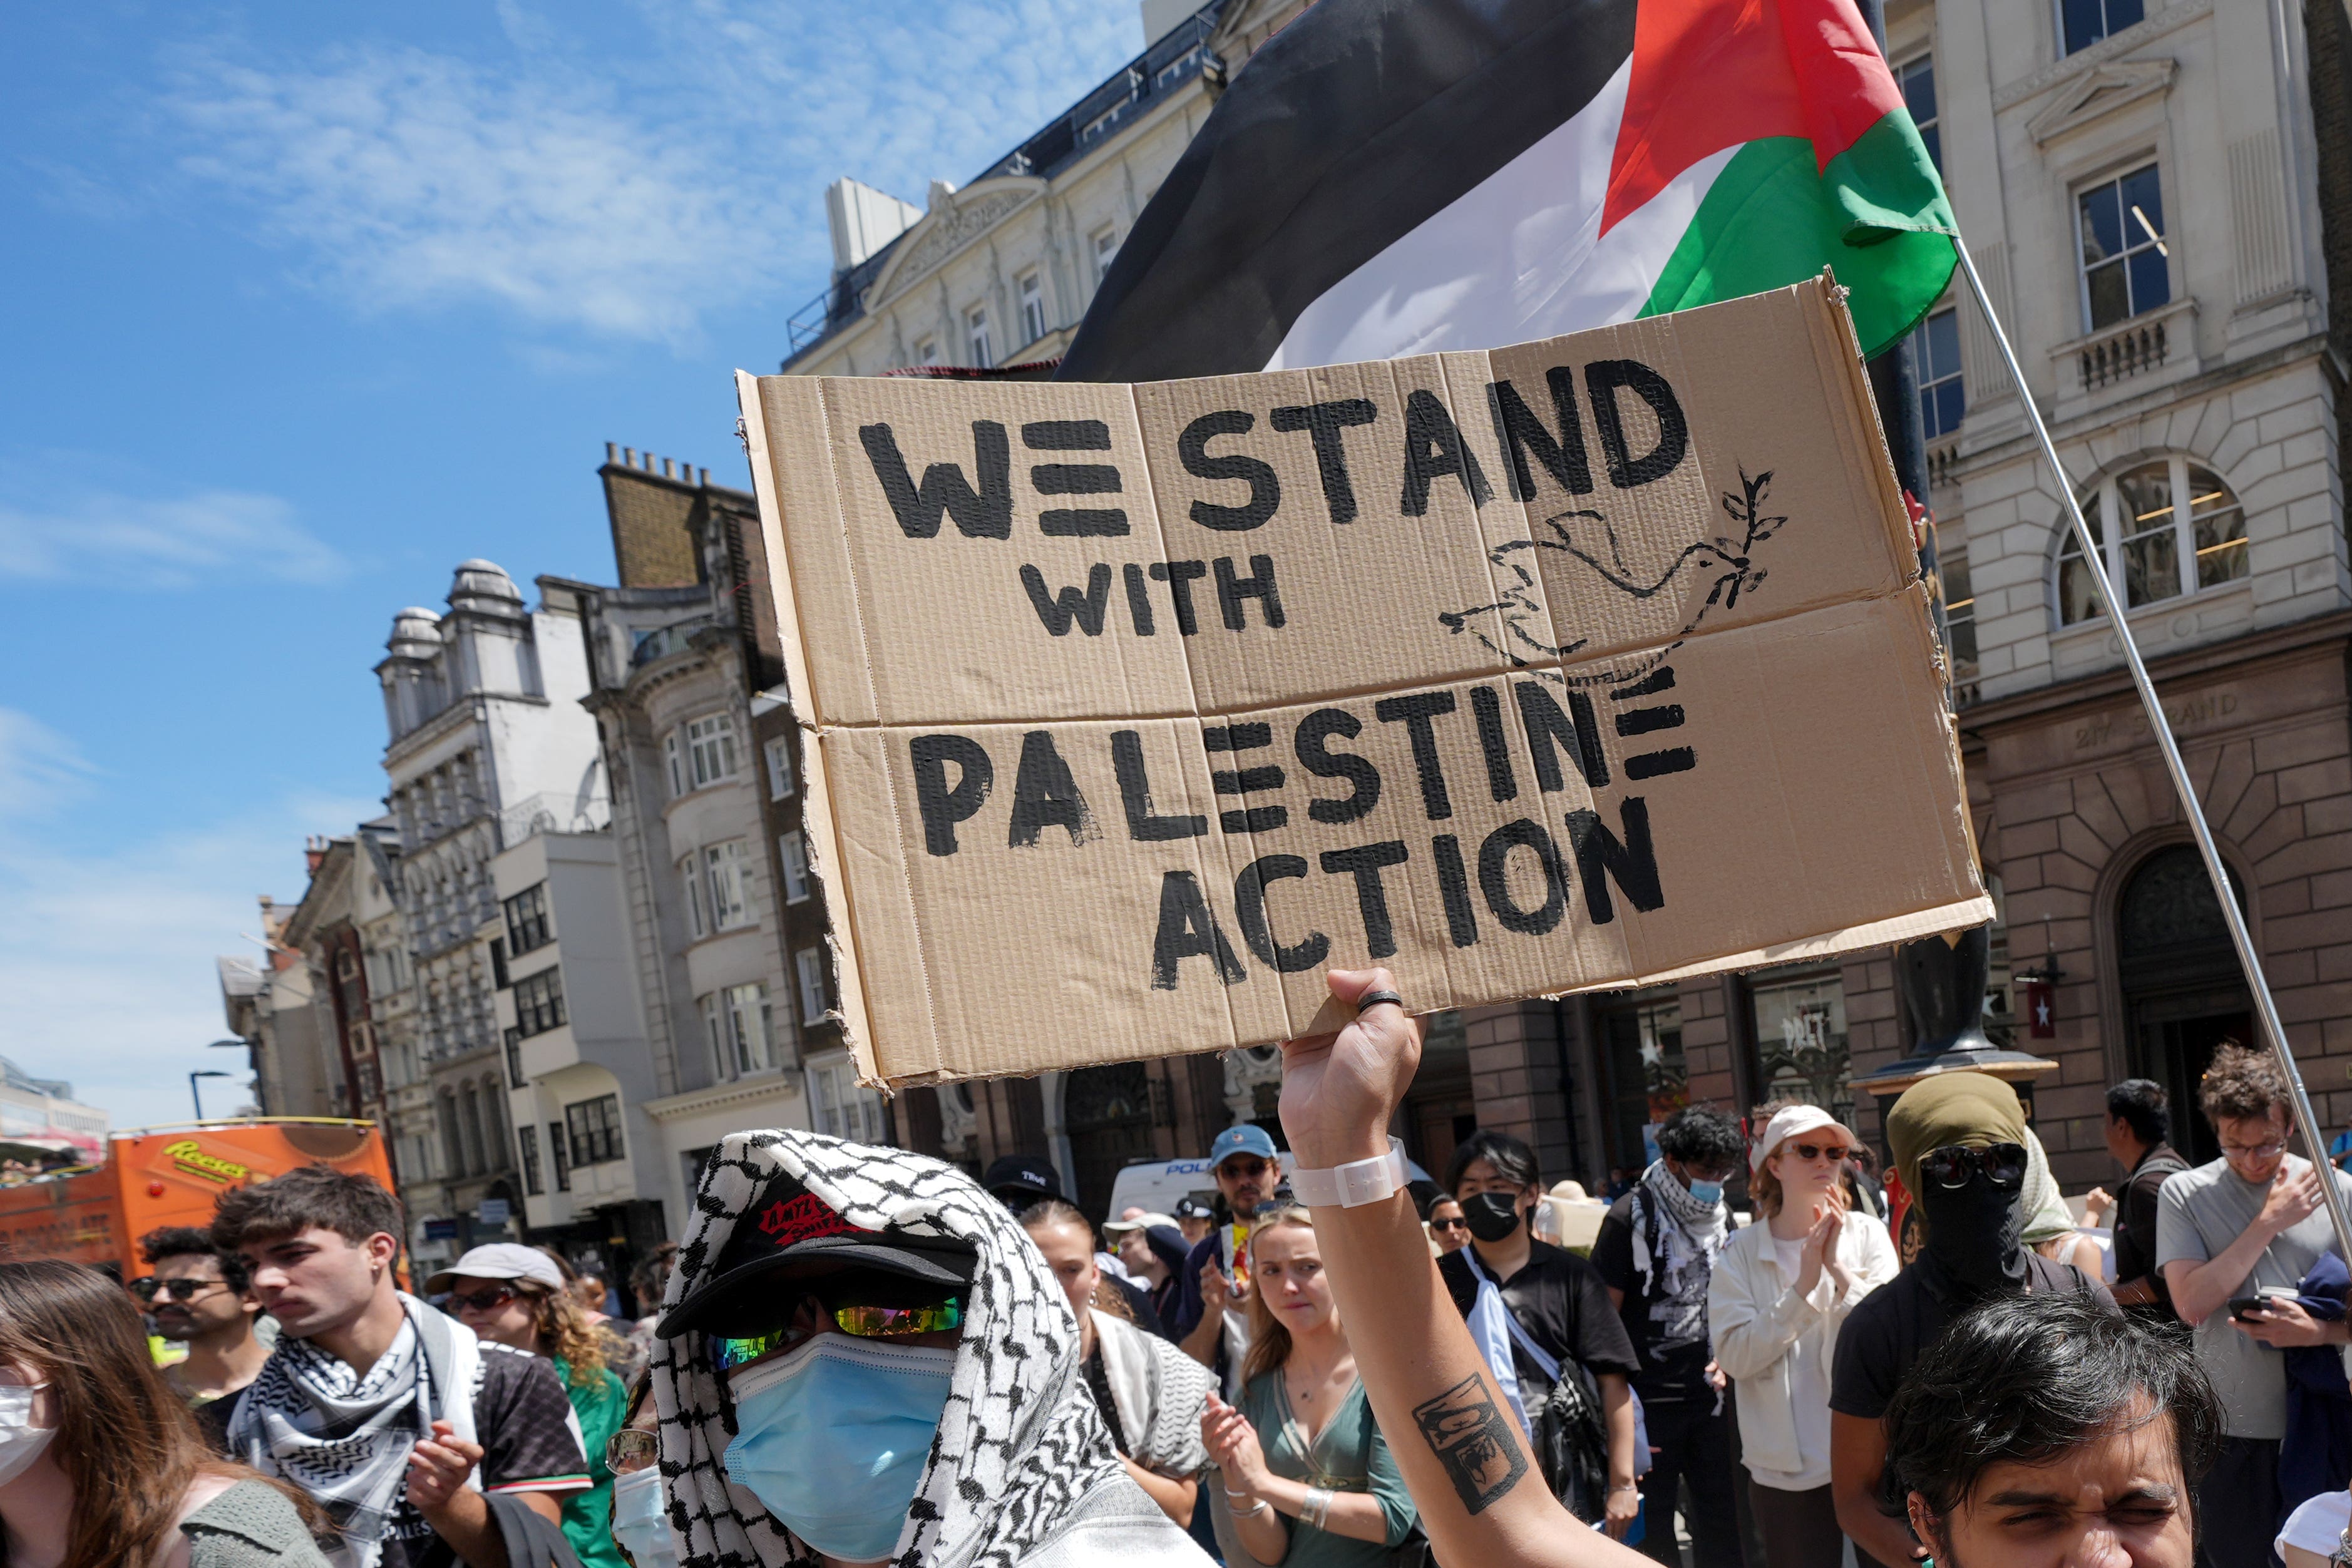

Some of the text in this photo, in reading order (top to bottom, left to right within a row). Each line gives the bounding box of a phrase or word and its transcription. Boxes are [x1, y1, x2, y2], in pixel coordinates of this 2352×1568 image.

[859, 359, 1690, 540] WE STAND
[1019, 555, 1286, 637] WITH
[910, 665, 1698, 856] PALESTINE
[2133, 694, 2237, 736] SRAND
[1152, 796, 1665, 991] ACTION
[1166, 1162, 1211, 1176] POLI
